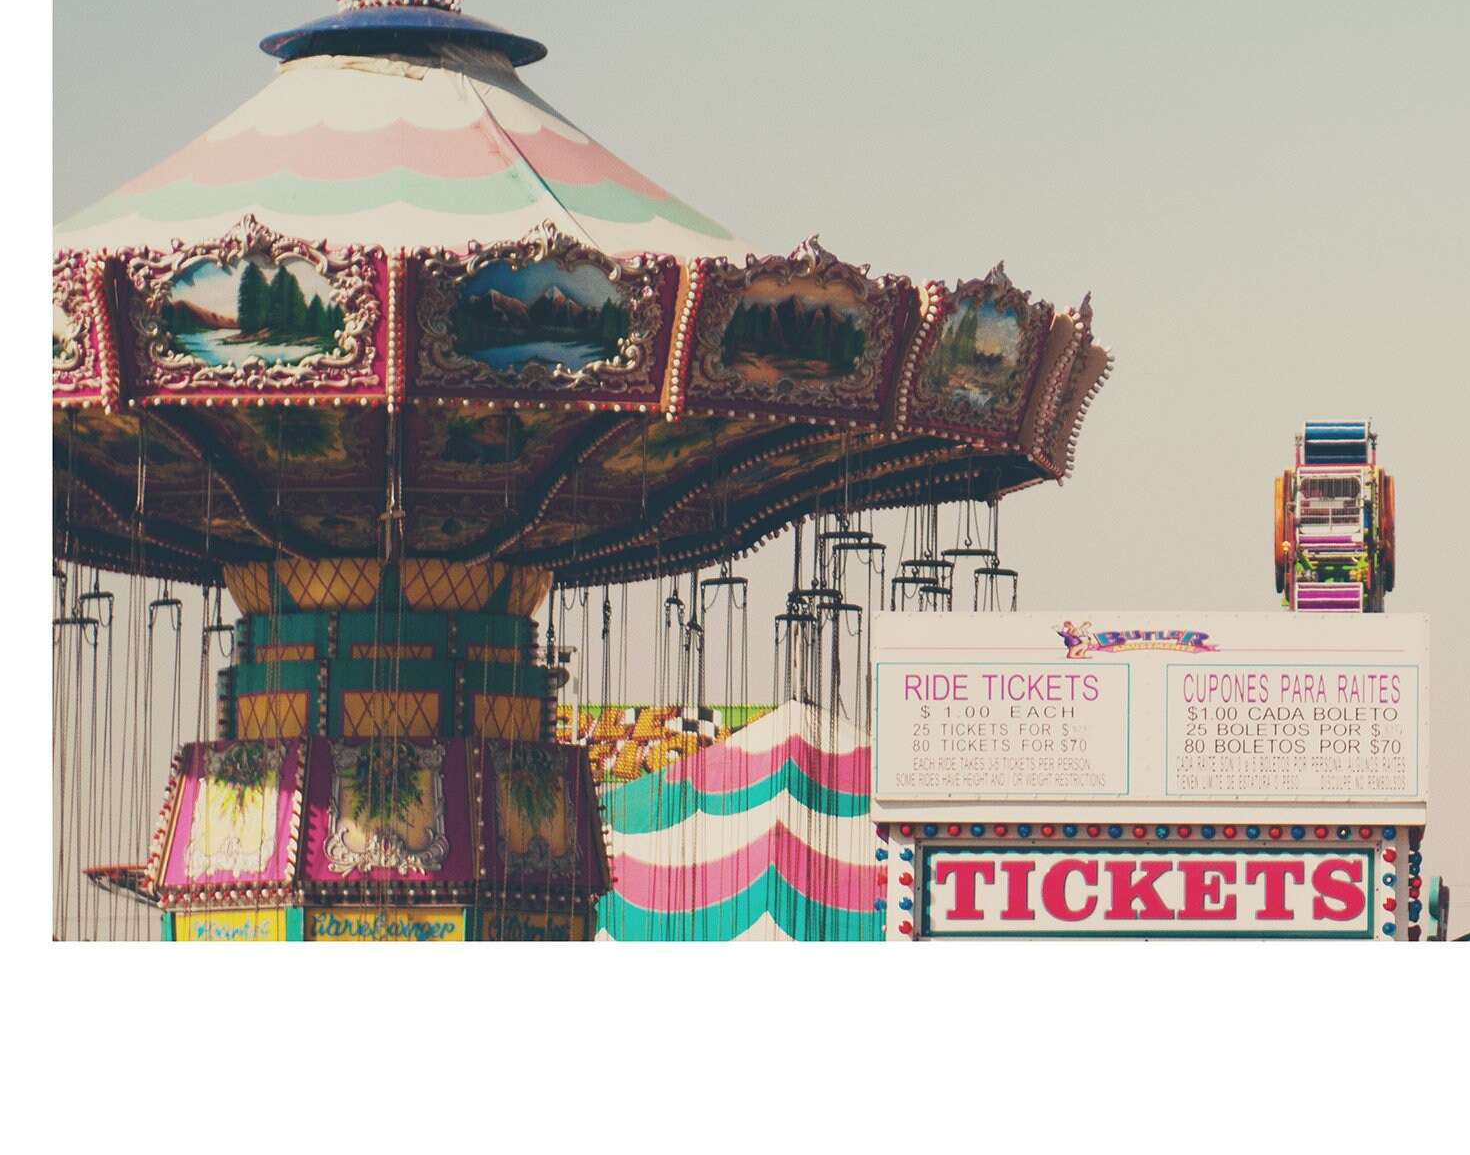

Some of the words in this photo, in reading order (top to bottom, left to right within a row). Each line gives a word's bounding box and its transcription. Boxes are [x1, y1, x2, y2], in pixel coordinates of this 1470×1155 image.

[1094, 630, 1209, 648] BUTLER
[904, 674, 969, 702] RIDE
[982, 674, 1099, 702] TICKETS
[1183, 674, 1269, 704] CUPONES
[1281, 674, 1327, 704] PARA
[1337, 674, 1401, 704] RAITES
[1010, 705, 1076, 719] EACH
[1187, 706, 1238, 722] $1.00
[1247, 706, 1305, 722] CADA
[1313, 706, 1398, 722] BOLETO
[912, 723, 931, 737] 25
[940, 723, 1009, 737] TICKETS
[1019, 723, 1052, 737] FOR
[1186, 723, 1207, 738] 25
[1217, 723, 1310, 738] BOLETOS
[1319, 723, 1362, 738] POR
[912, 739, 931, 753] 80
[941, 739, 1011, 753] TICKETS
[1021, 739, 1054, 753] FOR
[1060, 739, 1088, 753] $70
[1184, 738, 1205, 754] 80
[1214, 738, 1306, 754] BOLETOS
[1319, 738, 1361, 754] POR
[1370, 738, 1402, 754] $70
[913, 756, 935, 771] EACH
[938, 756, 957, 771] RIDE
[960, 756, 985, 771] TAKES
[1002, 756, 1036, 771] TICKETS
[1038, 756, 1055, 771] PER
[1057, 756, 1091, 771] PERSON
[896, 773, 916, 787] SOME
[919, 773, 940, 787] RIDES
[942, 773, 960, 787] HAVE
[963, 773, 989, 787] HEIGHT
[991, 773, 1006, 787] AND
[1025, 773, 1053, 787] WEIGHT
[1054, 773, 1106, 787] RESTRICTIONS
[935, 858, 1366, 922] TICKETS
